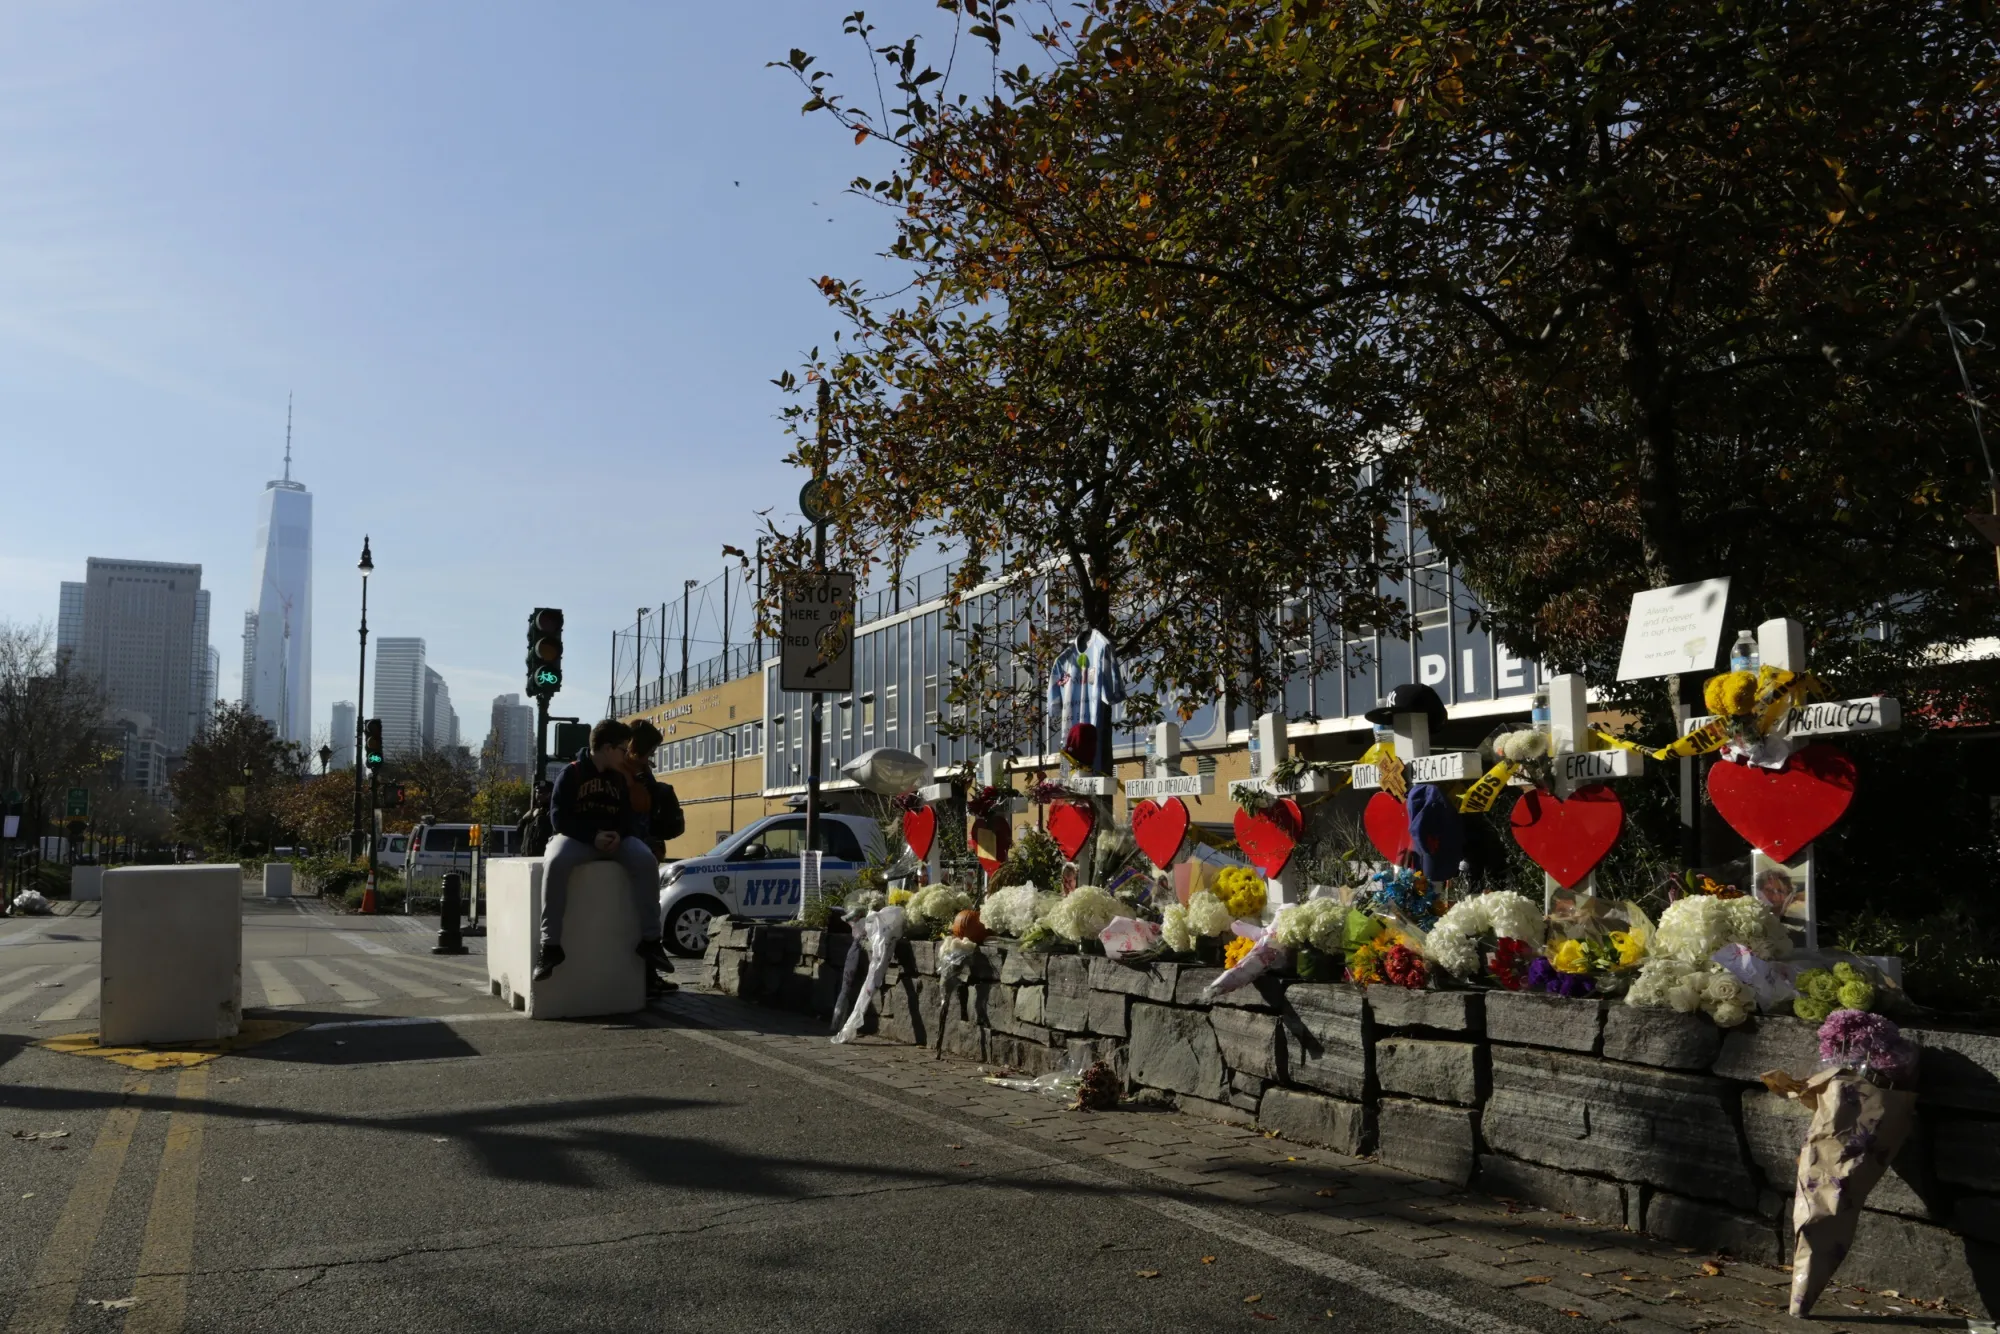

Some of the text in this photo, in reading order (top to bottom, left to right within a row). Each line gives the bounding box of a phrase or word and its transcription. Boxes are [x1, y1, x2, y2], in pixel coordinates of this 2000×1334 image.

[795, 587, 842, 603] STOP
[790, 609, 820, 620] HERE
[1645, 605, 1675, 616] Always
[1643, 613, 1695, 627] and Forever
[1651, 628, 1665, 636] our
[1668, 623, 1697, 634] Hearts
[787, 635, 809, 646] RED
[694, 864, 728, 874] POLICE
